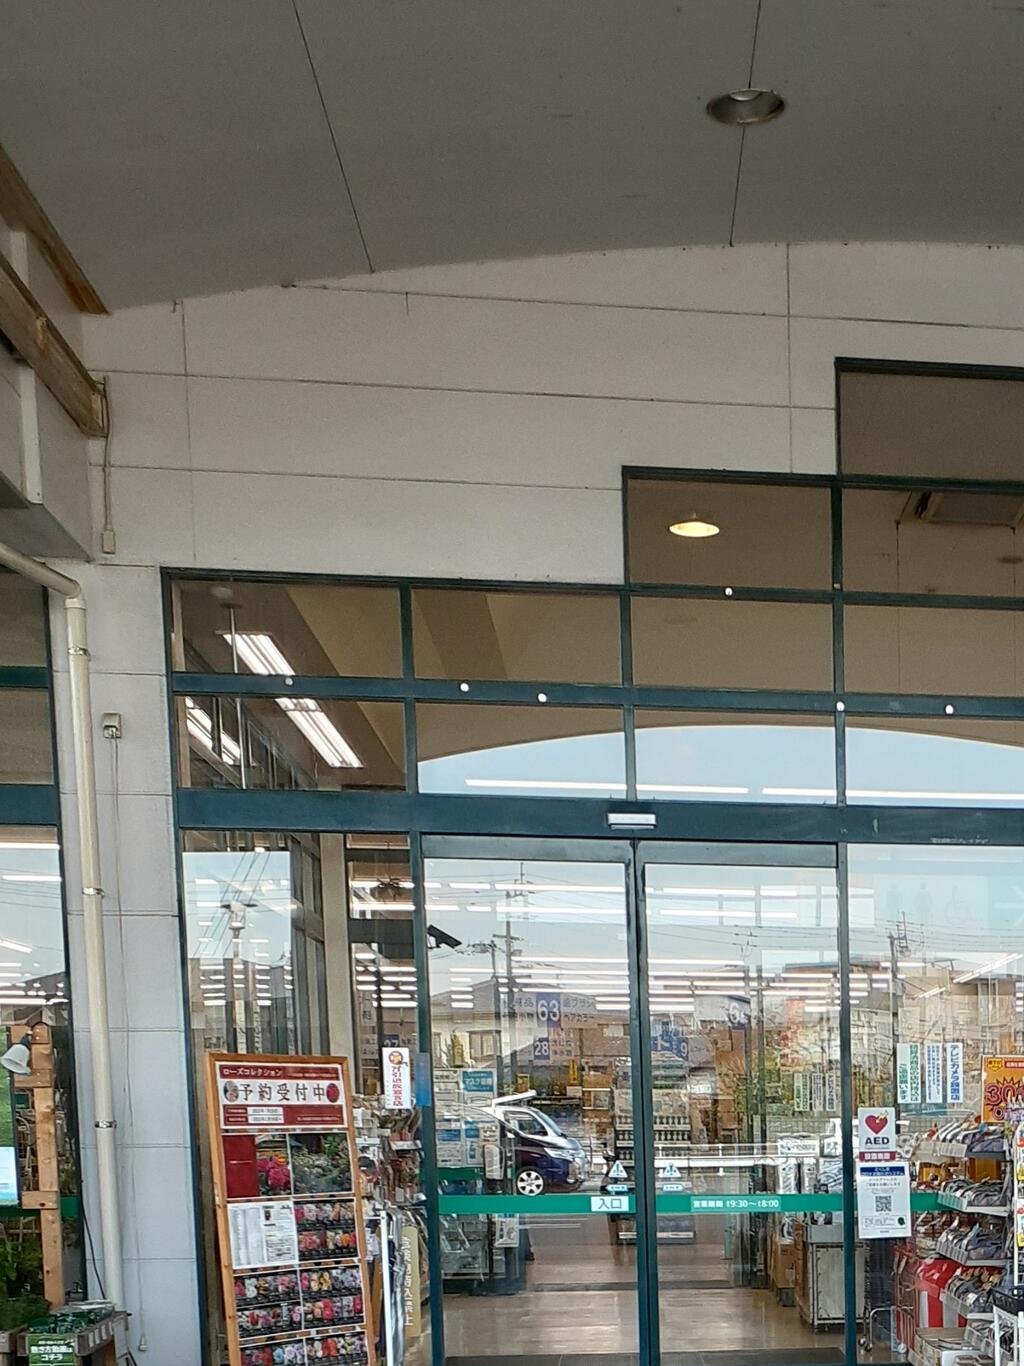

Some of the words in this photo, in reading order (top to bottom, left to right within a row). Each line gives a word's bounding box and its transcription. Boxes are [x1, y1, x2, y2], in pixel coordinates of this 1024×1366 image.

[538, 1000, 560, 1021] 63
[534, 1041, 549, 1056] 28
[223, 1067, 282, 1077] ローズコレクション
[238, 1082, 325, 1102] 予約受付中
[865, 1136, 890, 1145] AED
[598, 1198, 622, 1209] 入口
[41, 1353, 63, 1361] コチラ
